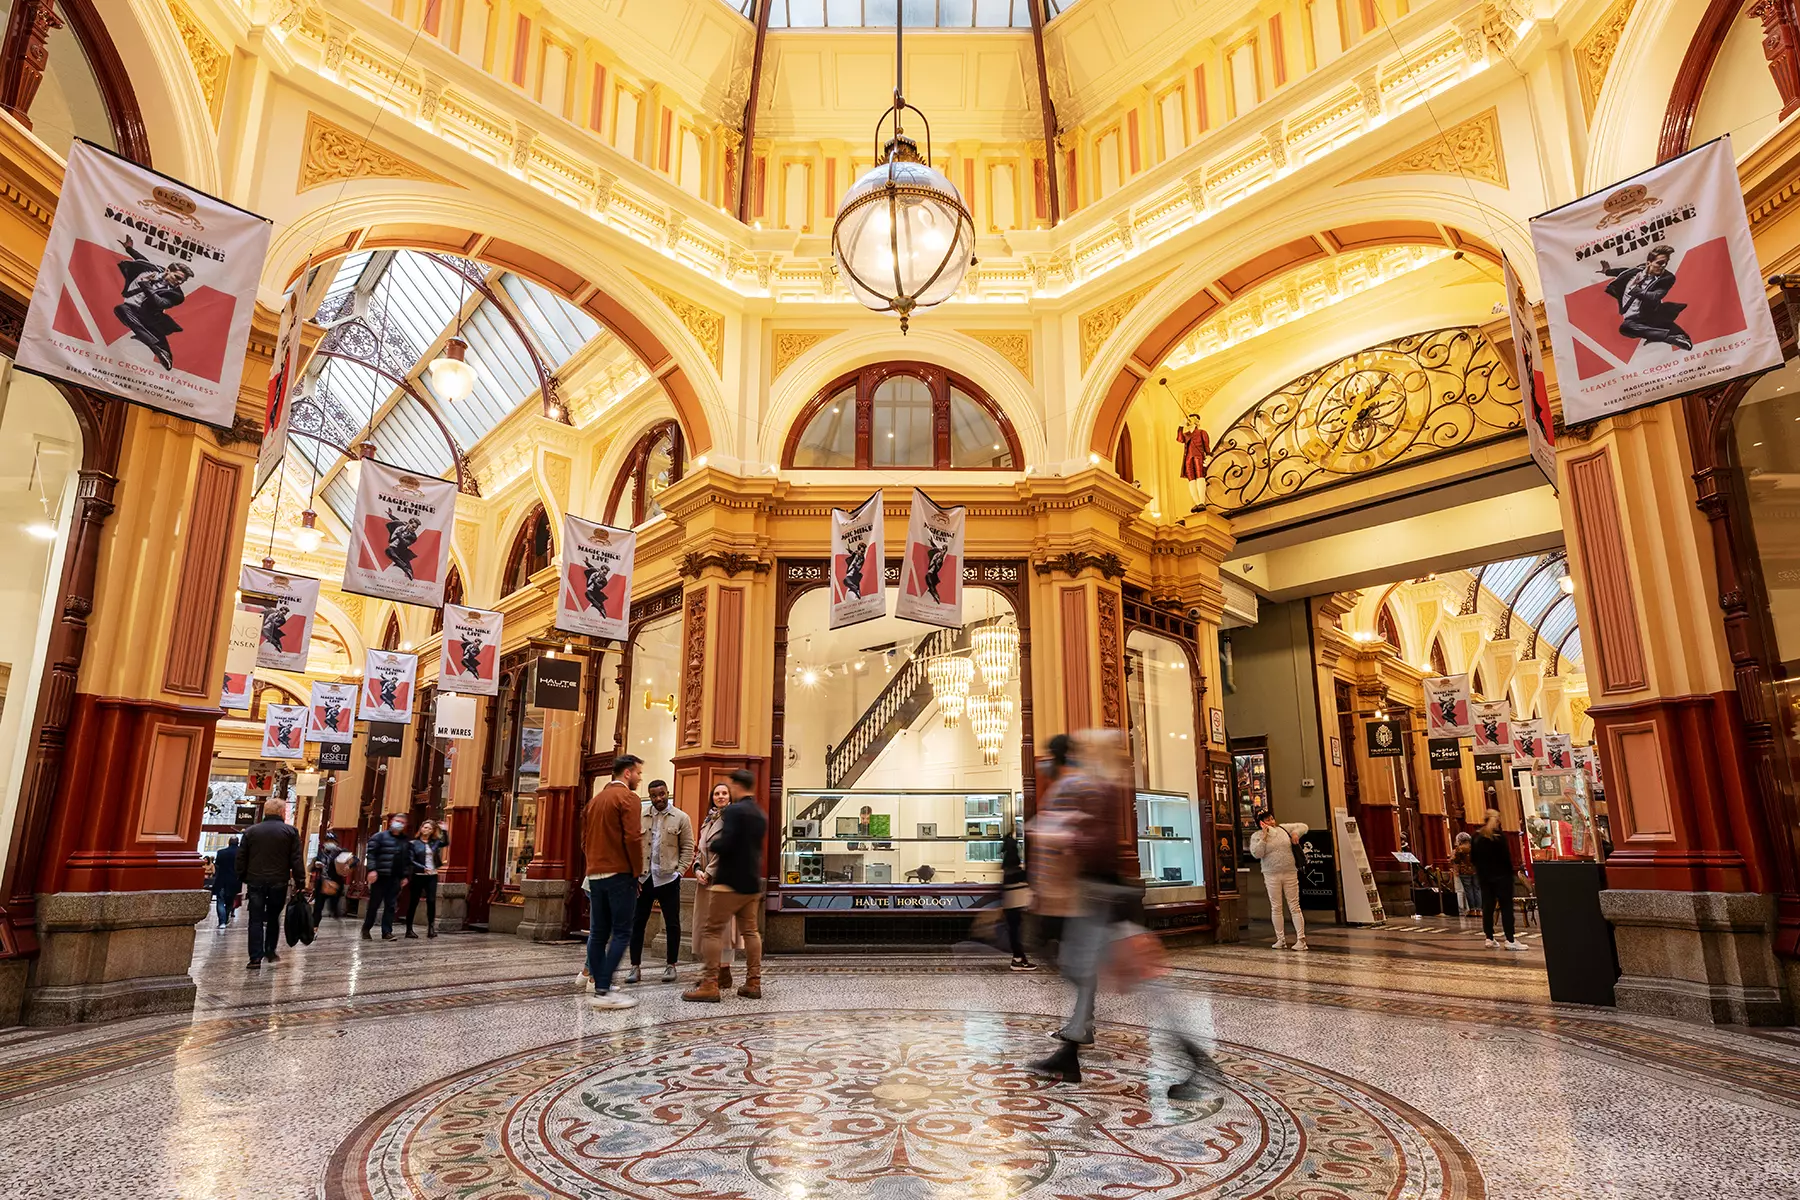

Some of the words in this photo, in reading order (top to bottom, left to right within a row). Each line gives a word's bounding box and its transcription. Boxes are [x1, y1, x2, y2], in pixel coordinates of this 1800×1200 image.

[157, 190, 192, 209] BLOCK
[1607, 188, 1646, 208] BLOCK
[104, 207, 170, 242] MAGIC
[173, 235, 226, 263] MIKE
[107, 202, 154, 224] CHANNING
[157, 223, 183, 236] TATUM
[186, 235, 226, 254] PRESENTS
[1574, 232, 1617, 251] CHANNING
[1621, 220, 1647, 233] TATUM
[1650, 202, 1694, 221] PRESENTS
[1575, 230, 1636, 262] MAGIC
[1640, 207, 1697, 236] MIKE
[144, 235, 193, 262] LIVE
[1615, 230, 1666, 256] LIVE
[48, 338, 90, 358] "LEAVES
[95, 354, 113, 364] THE
[118, 361, 155, 376] CROWD
[159, 372, 219, 396] BREATHLESS"
[1580, 378, 1618, 393] "LEAVES
[1620, 372, 1639, 381] THE
[1642, 359, 1679, 375] CROWD
[1684, 338, 1752, 362] BREATHLESS"
[1676, 376, 1696, 384] NOW
[1699, 364, 1732, 377] PLAYING
[91, 367, 176, 394] MAGICMIKELIVE.COM.AU
[1623, 364, 1707, 393] MAGICMIKELIVE.COM.AU
[144, 389, 163, 399] NOW
[378, 494, 409, 507] MAGIC
[410, 502, 436, 514] MIKE
[397, 506, 420, 516] LIVE
[848, 534, 863, 544] LIVE
[578, 545, 600, 555] MAGIC
[601, 551, 621, 560] MIKE
[592, 555, 609, 563] LIVE
[540, 678, 577, 687] HAUTE
[607, 698, 615, 710] 21
[450, 728, 472, 736] WARES
[321, 753, 348, 761] KESHETT
